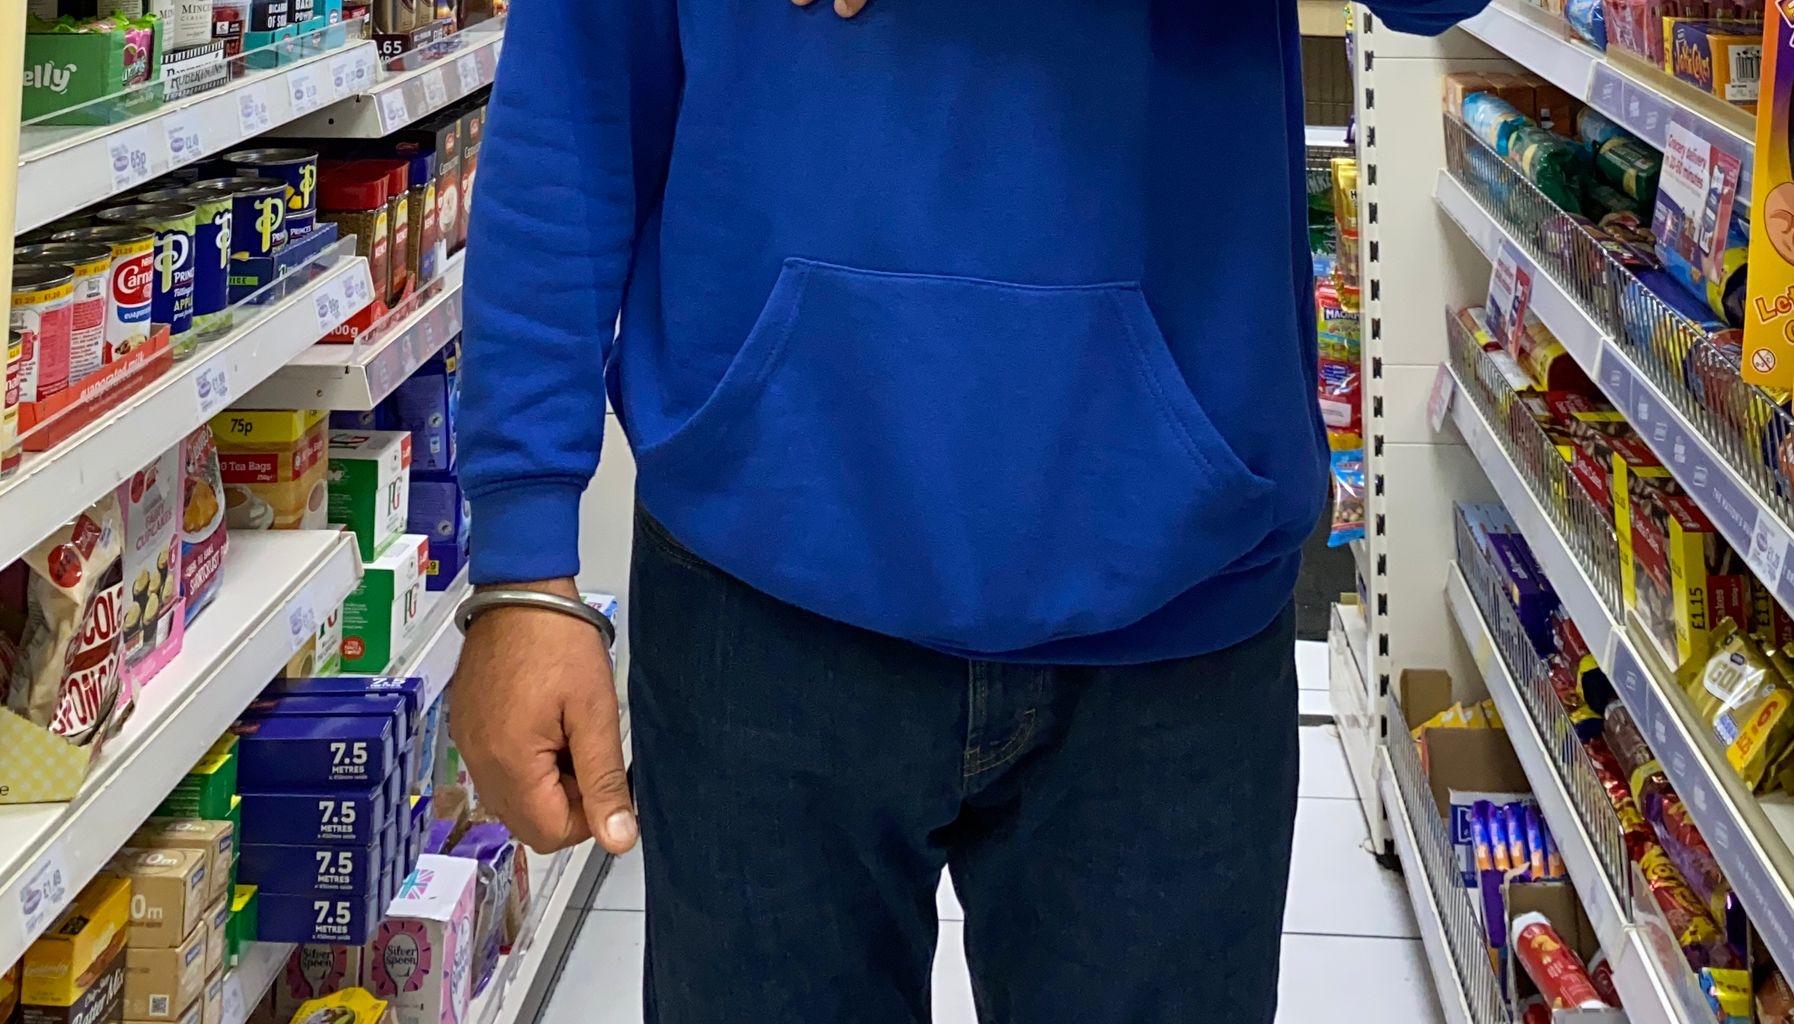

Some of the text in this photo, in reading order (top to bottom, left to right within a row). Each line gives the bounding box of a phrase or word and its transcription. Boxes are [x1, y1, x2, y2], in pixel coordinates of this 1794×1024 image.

[130, 149, 147, 168] 65p
[230, 418, 253, 436] 75p
[227, 460, 272, 475] Tea Bags
[1688, 586, 1706, 630] £1.15
[330, 742, 368, 764] 7.5
[331, 765, 365, 774] METRES
[319, 801, 356, 823] 7.5
[320, 824, 353, 833] METRES
[316, 851, 353, 874] 7.5
[317, 875, 350, 884] METRES
[313, 901, 351, 924] 7.5
[315, 925, 348, 934] METRES
[303, 946, 333, 960] Silver
[387, 944, 418, 958] Silver
[302, 958, 334, 972] Spoon
[385, 956, 418, 971] Spoon
